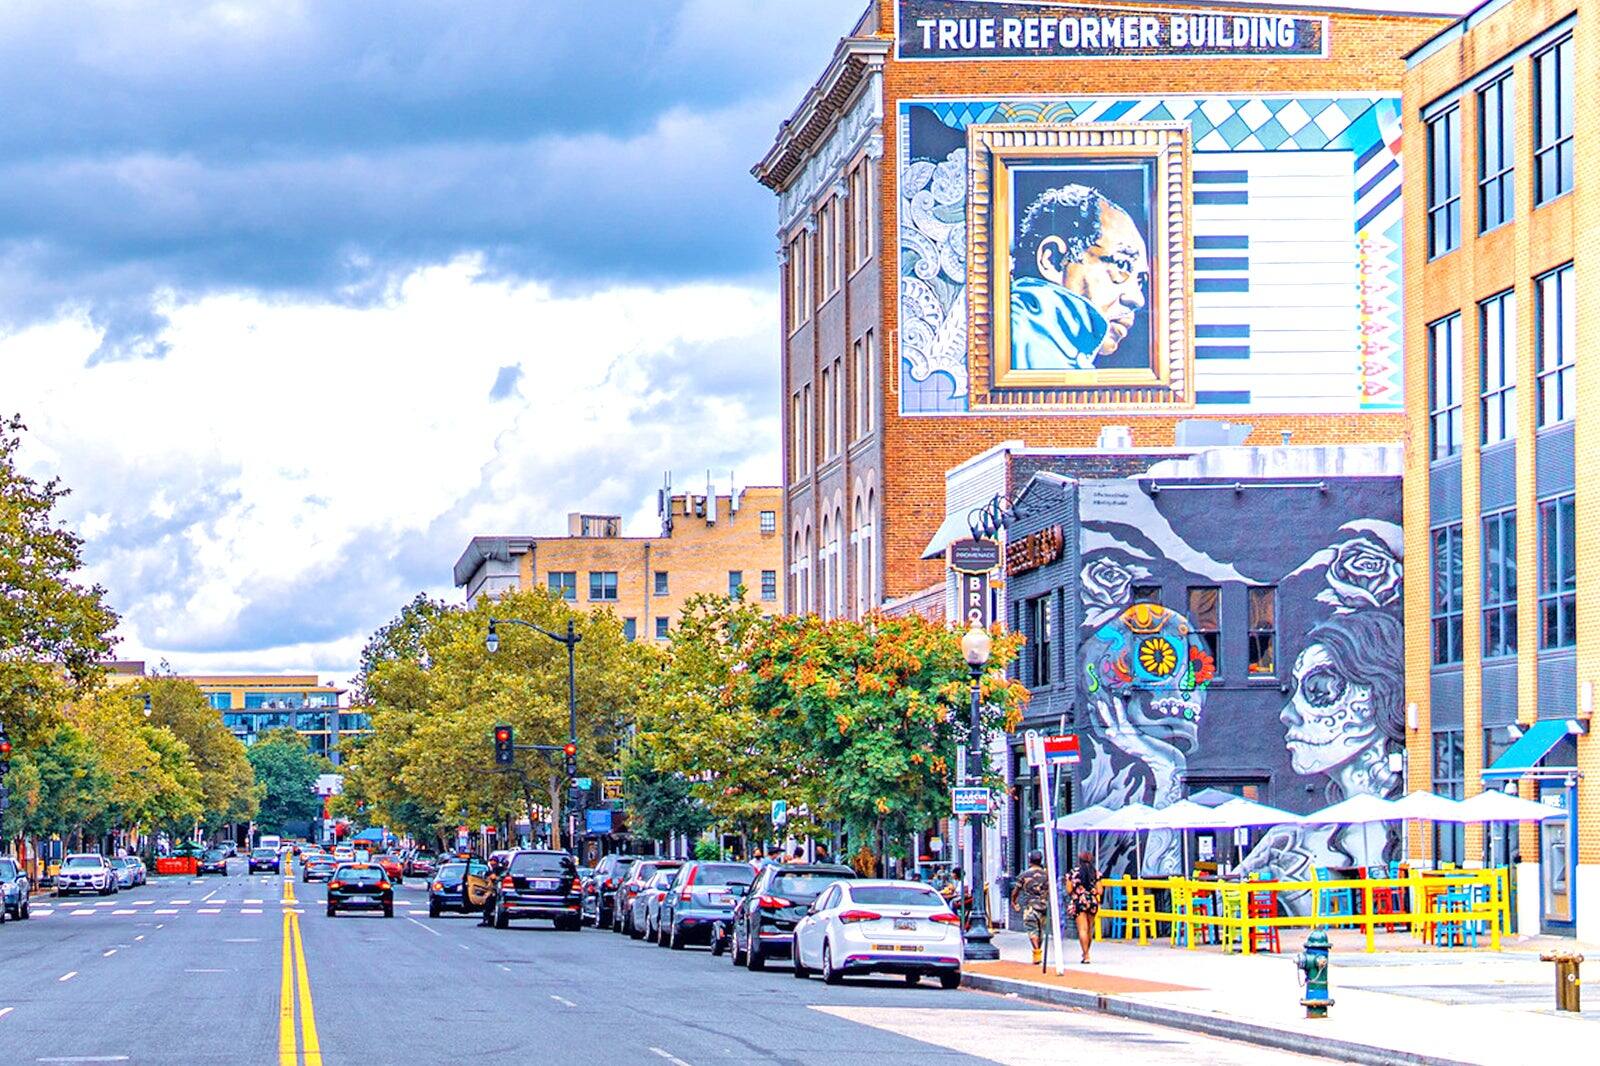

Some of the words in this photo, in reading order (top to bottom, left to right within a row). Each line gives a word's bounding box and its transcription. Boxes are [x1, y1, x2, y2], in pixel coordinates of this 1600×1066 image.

[916, 18, 996, 50] TRUE
[1003, 17, 1161, 49] REFORMER
[1170, 17, 1296, 48] BUILDING
[955, 551, 996, 559] PROMENADE
